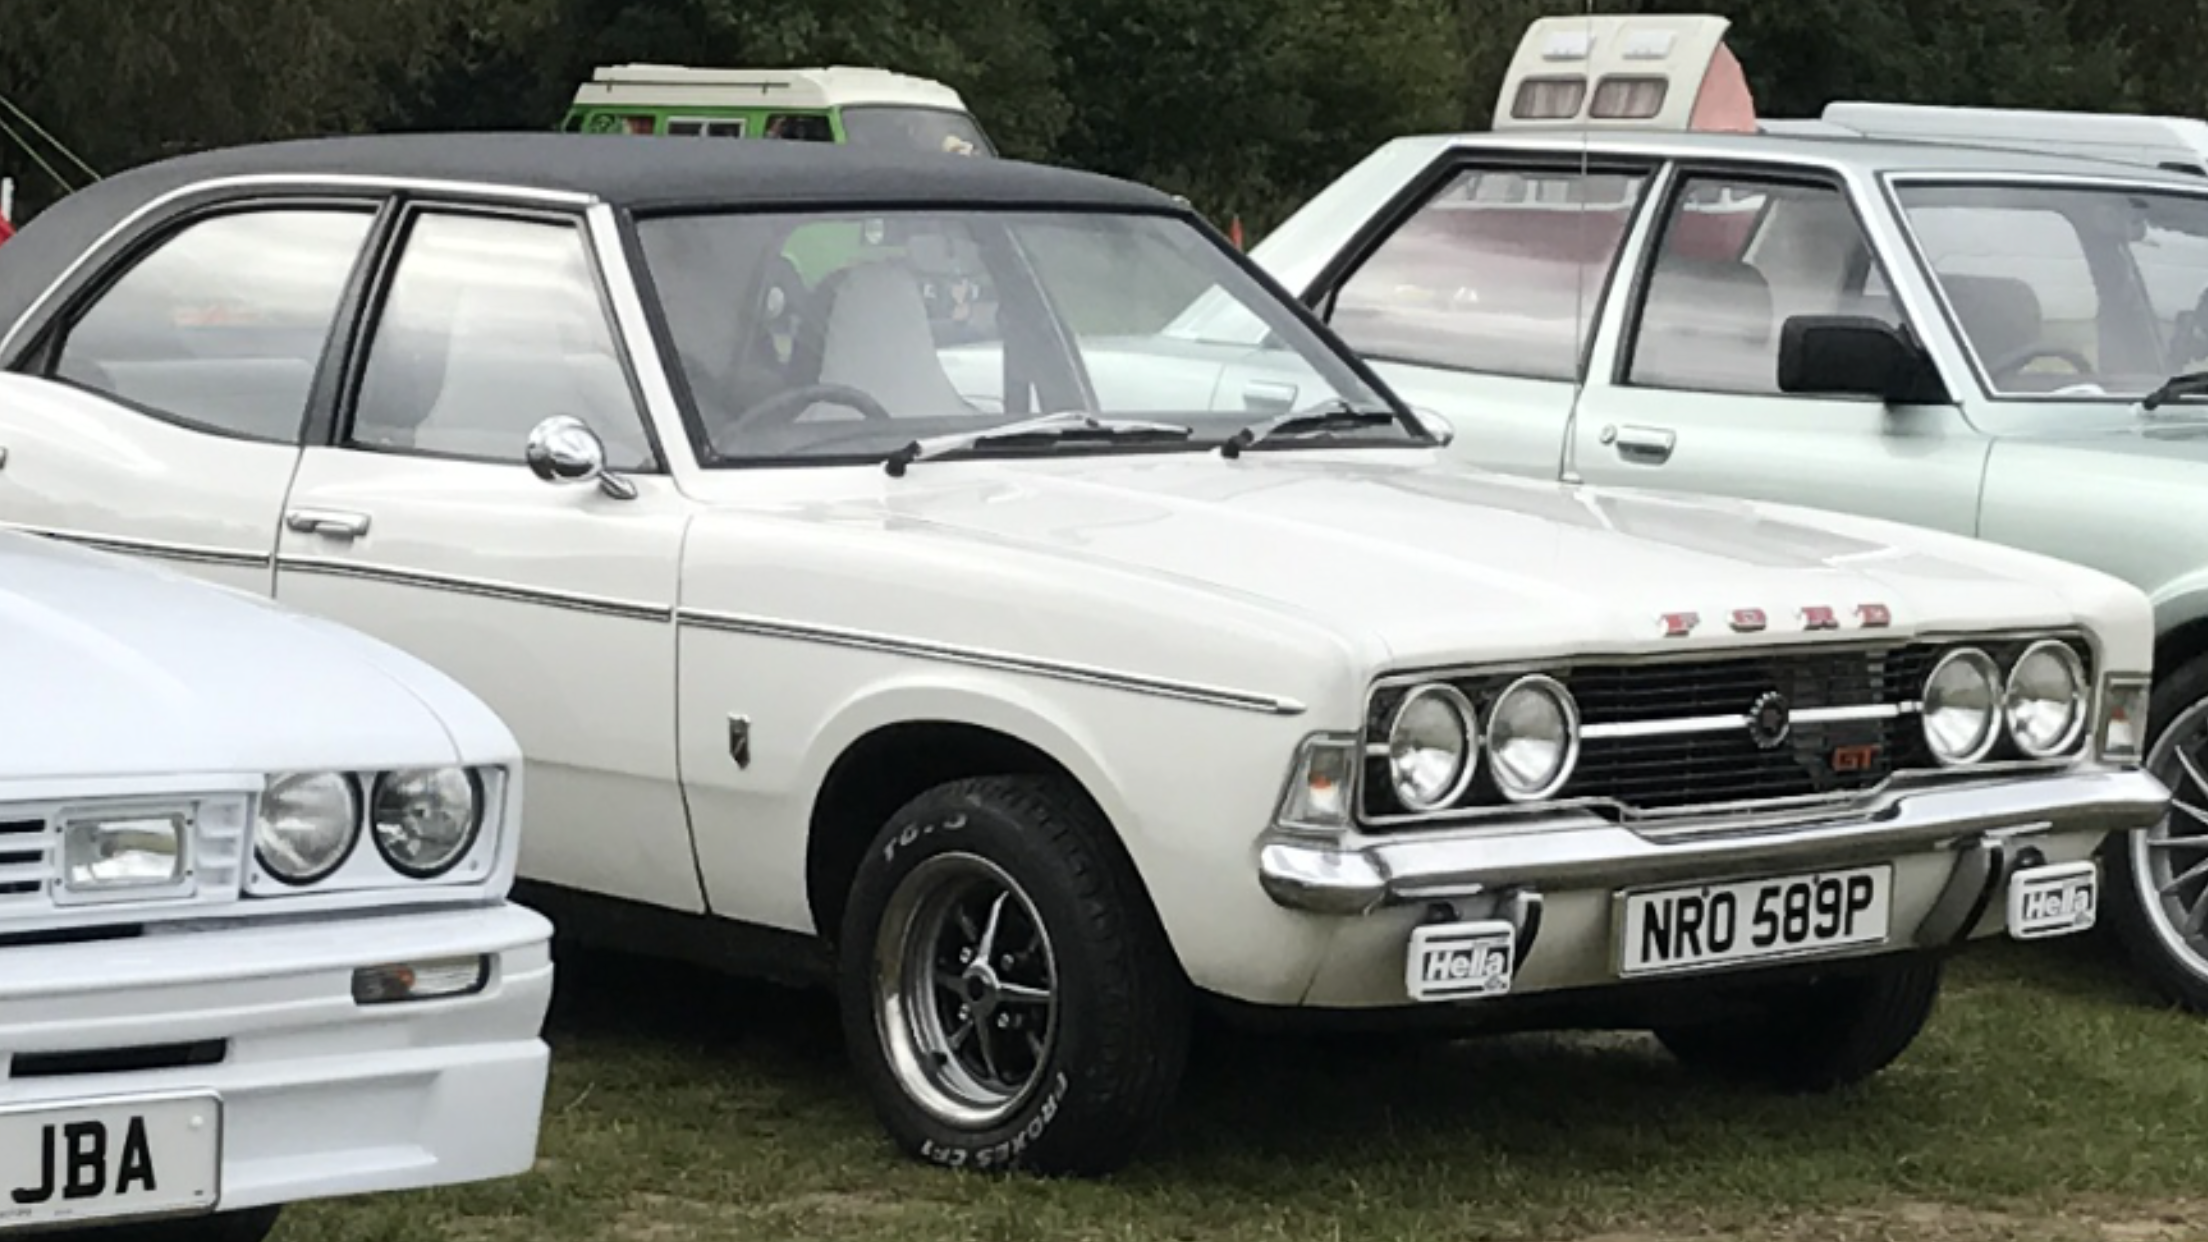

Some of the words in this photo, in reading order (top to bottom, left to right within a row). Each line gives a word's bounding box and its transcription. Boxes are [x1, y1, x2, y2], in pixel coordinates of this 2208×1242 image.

[1658, 603, 1891, 637] FORD
[1832, 745, 1882, 771] GT
[1641, 891, 1736, 963] NRO
[1752, 875, 1874, 947] 589P
[2025, 883, 2090, 919] Hella
[1426, 942, 1506, 980] Hella
[11, 1116, 156, 1204] JBA
